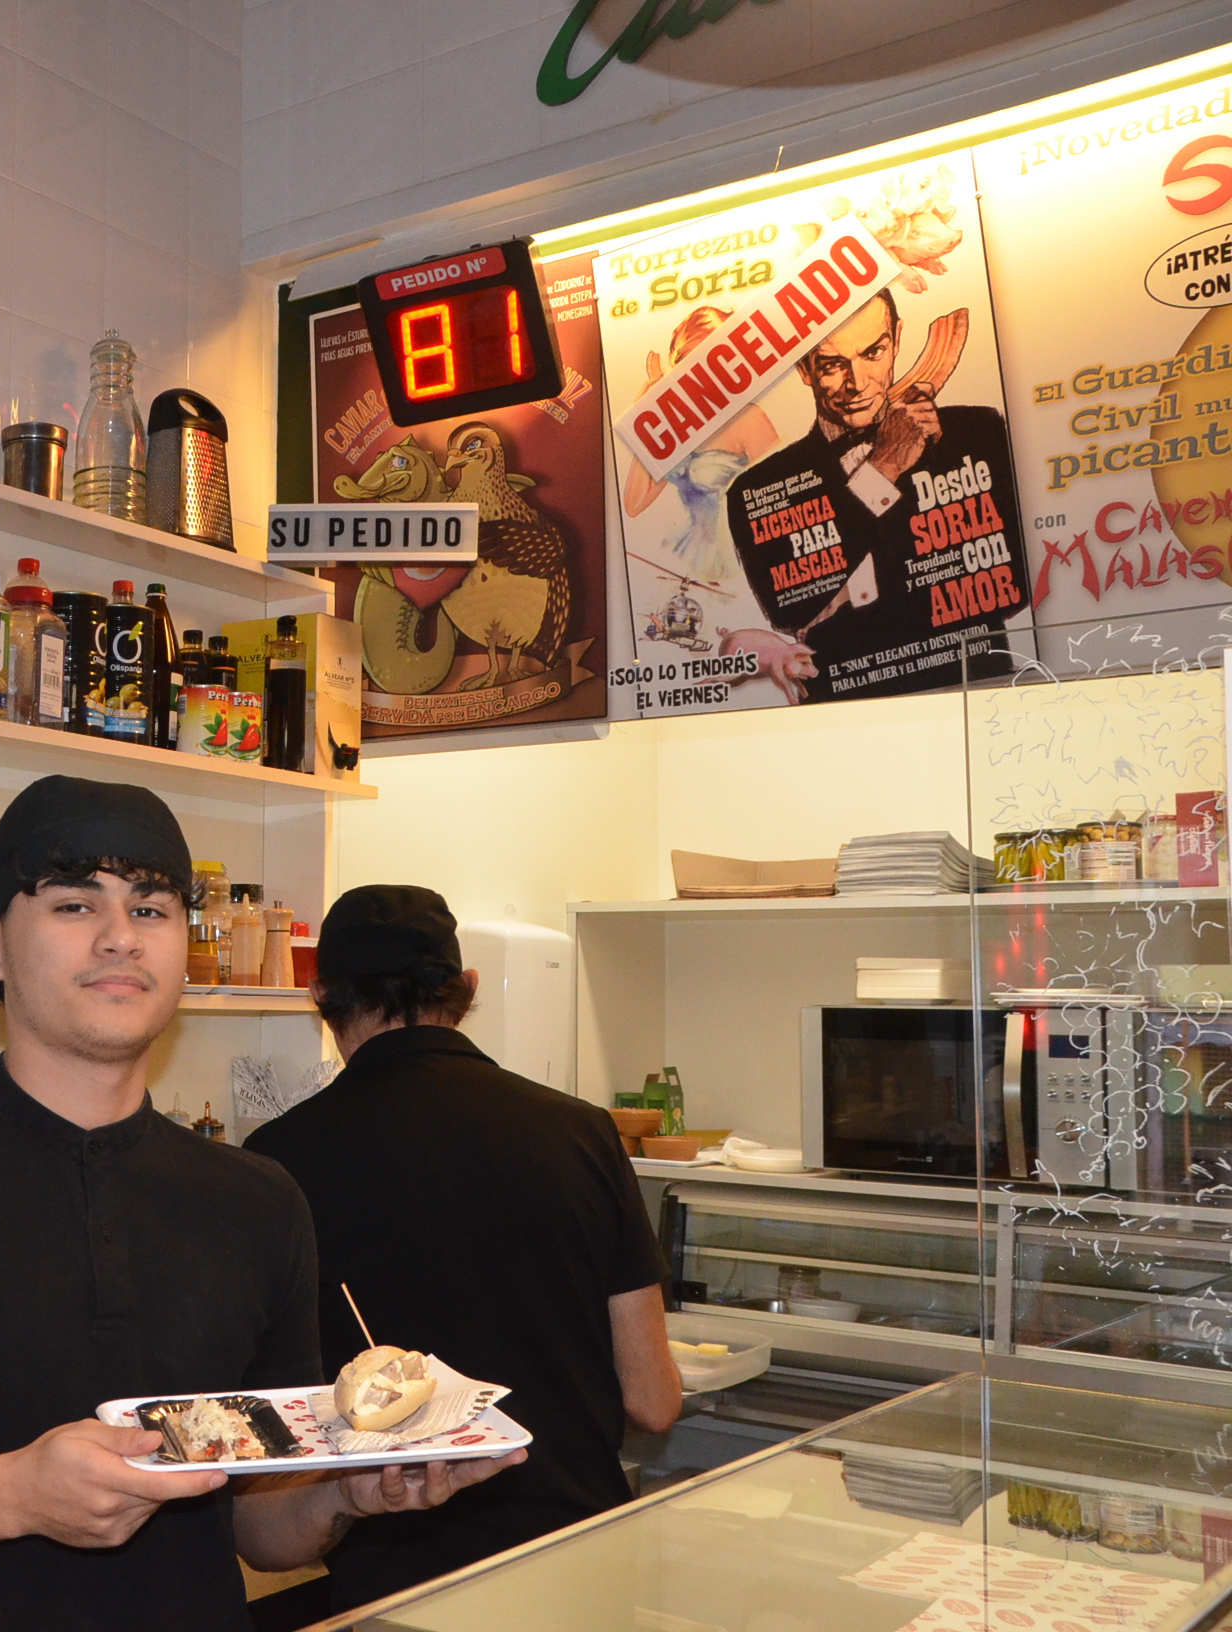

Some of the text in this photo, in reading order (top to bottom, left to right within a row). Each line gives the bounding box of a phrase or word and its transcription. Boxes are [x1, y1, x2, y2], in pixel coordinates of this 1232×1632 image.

[610, 223, 779, 280] Torrezno
[391, 264, 462, 292] PEDIDO
[611, 259, 775, 318] de Soria
[400, 289, 522, 400] 81
[633, 234, 879, 461] CANCELADO
[1035, 383, 1064, 403] El
[324, 389, 384, 453] CAVIAR
[1071, 392, 1182, 435] Civil
[742, 489, 752, 501] El
[752, 480, 784, 498] torrezno
[784, 475, 799, 488] que
[745, 474, 822, 511] su fritura y horneado
[911, 455, 992, 512] Desde
[271, 516, 462, 548] SU PEDIDO
[748, 505, 773, 520] cuenta
[750, 495, 836, 545] LICENCIA
[909, 491, 1004, 555] SORIA
[1034, 513, 1066, 530] con
[789, 520, 842, 558] PARA
[962, 532, 1011, 574] con
[769, 545, 848, 592] MASCAR
[905, 548, 961, 575] Trepidante
[1033, 530, 1232, 612] MALAS
[906, 579, 913, 593] y
[930, 565, 1021, 627] AMOR
[324, 671, 346, 682] ALVEAR
[610, 649, 757, 687] ¡SOLO LO TENDRÁS
[829, 664, 841, 677] EL
[875, 642, 922, 664] ELEGANTE
[922, 641, 928, 650] Y
[832, 678, 856, 693] PARA
[857, 677, 868, 687] LA
[868, 667, 898, 684] MUJER
[899, 666, 905, 676] Y
[906, 662, 917, 673] EL
[917, 649, 956, 671] HOMBRE
[968, 639, 992, 657] HOY!
[403, 687, 504, 710] DELICATESSEN
[436, 710, 465, 723] POR
[466, 682, 562, 720] ENCARGO
[637, 692, 653, 710] EL
